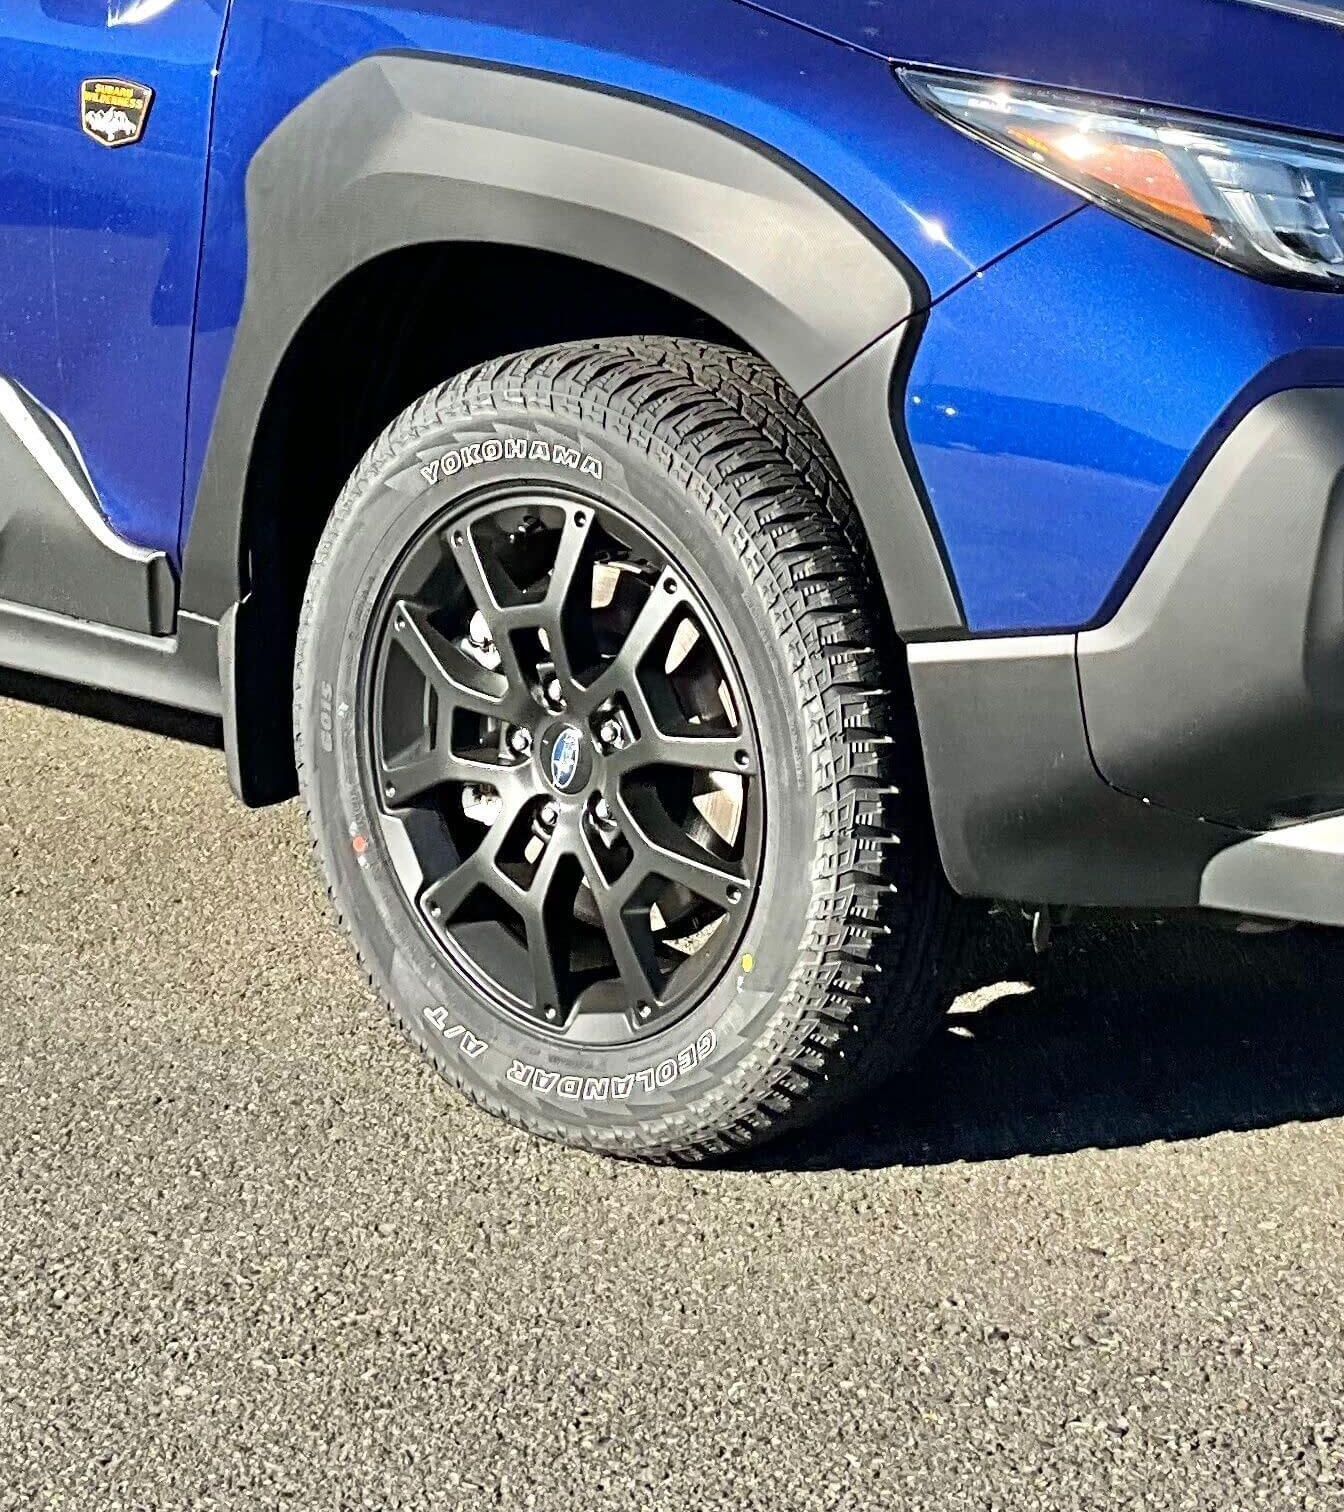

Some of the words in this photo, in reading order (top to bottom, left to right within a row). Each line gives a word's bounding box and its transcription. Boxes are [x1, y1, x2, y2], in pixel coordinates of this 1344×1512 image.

[420, 438, 604, 486] YOKOHAMA
[422, 1005, 489, 1058] A/T
[506, 1028, 718, 1101] GEOLANDAR
